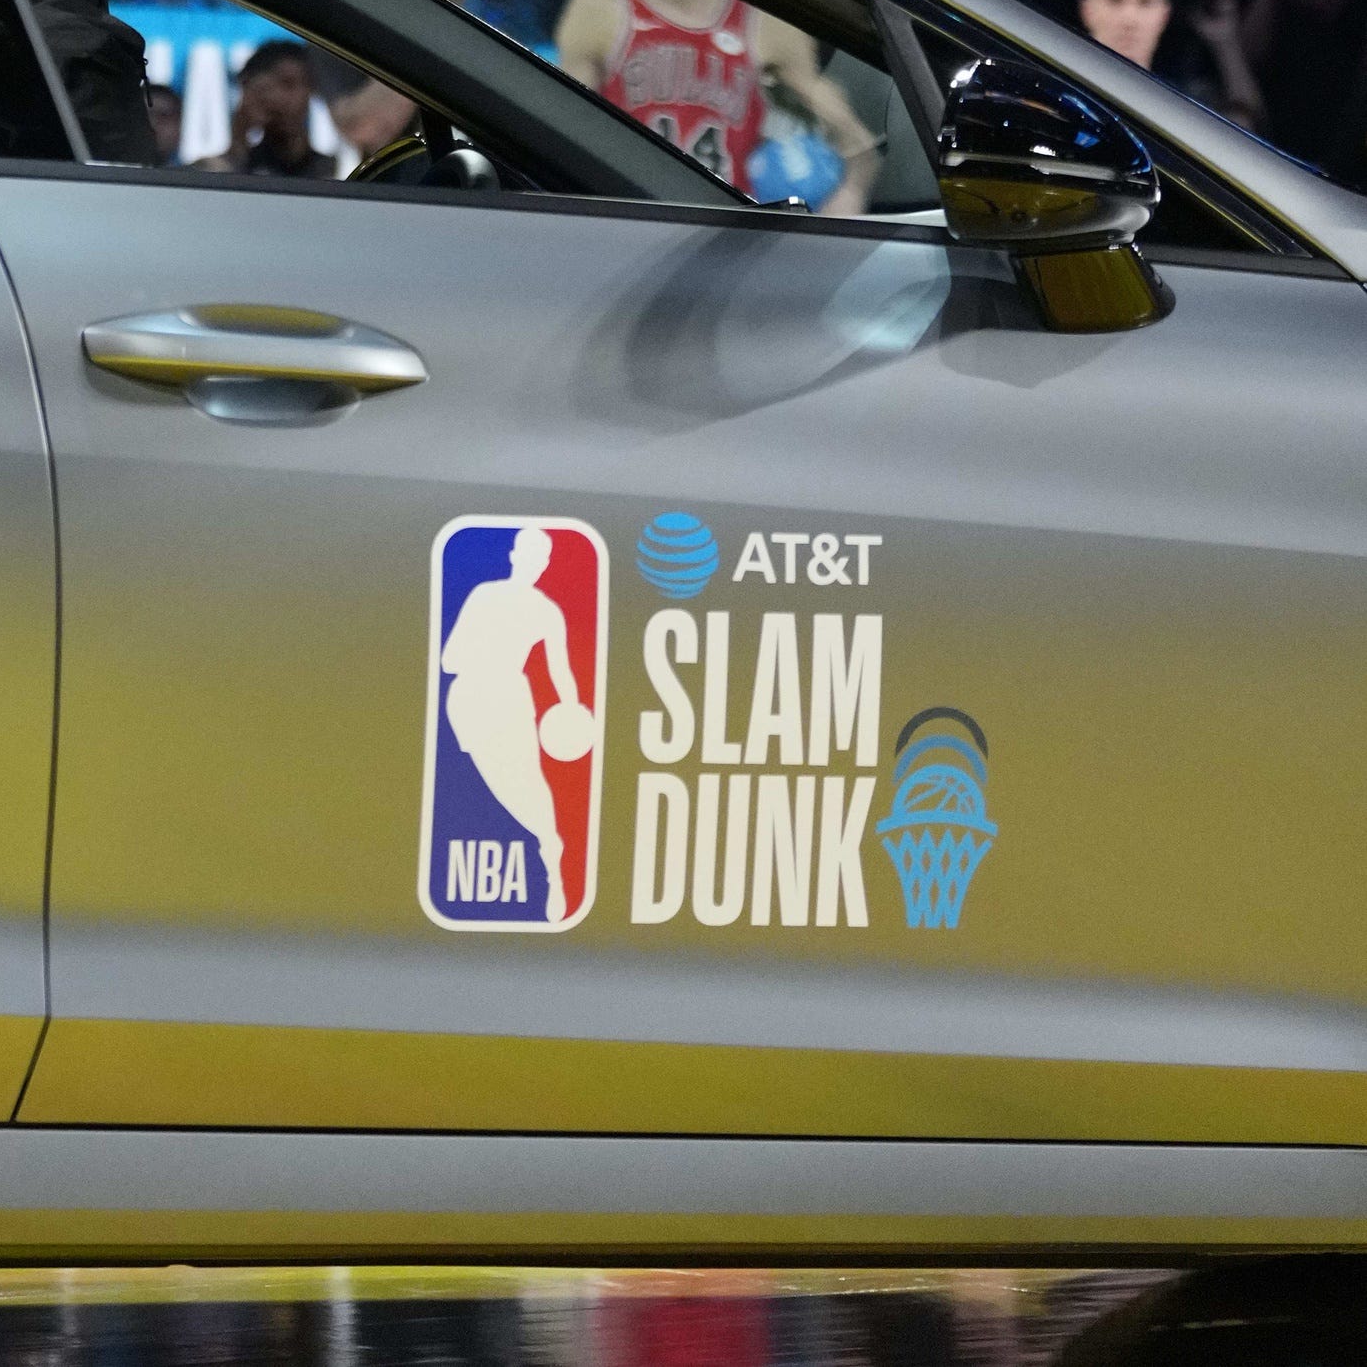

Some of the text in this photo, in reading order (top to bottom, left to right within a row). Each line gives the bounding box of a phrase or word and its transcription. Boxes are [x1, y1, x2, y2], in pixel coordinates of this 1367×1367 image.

[732, 532, 883, 587] AT&T
[638, 609, 883, 768] SLAM
[445, 839, 528, 904] NBA
[630, 772, 878, 929] DUNK
